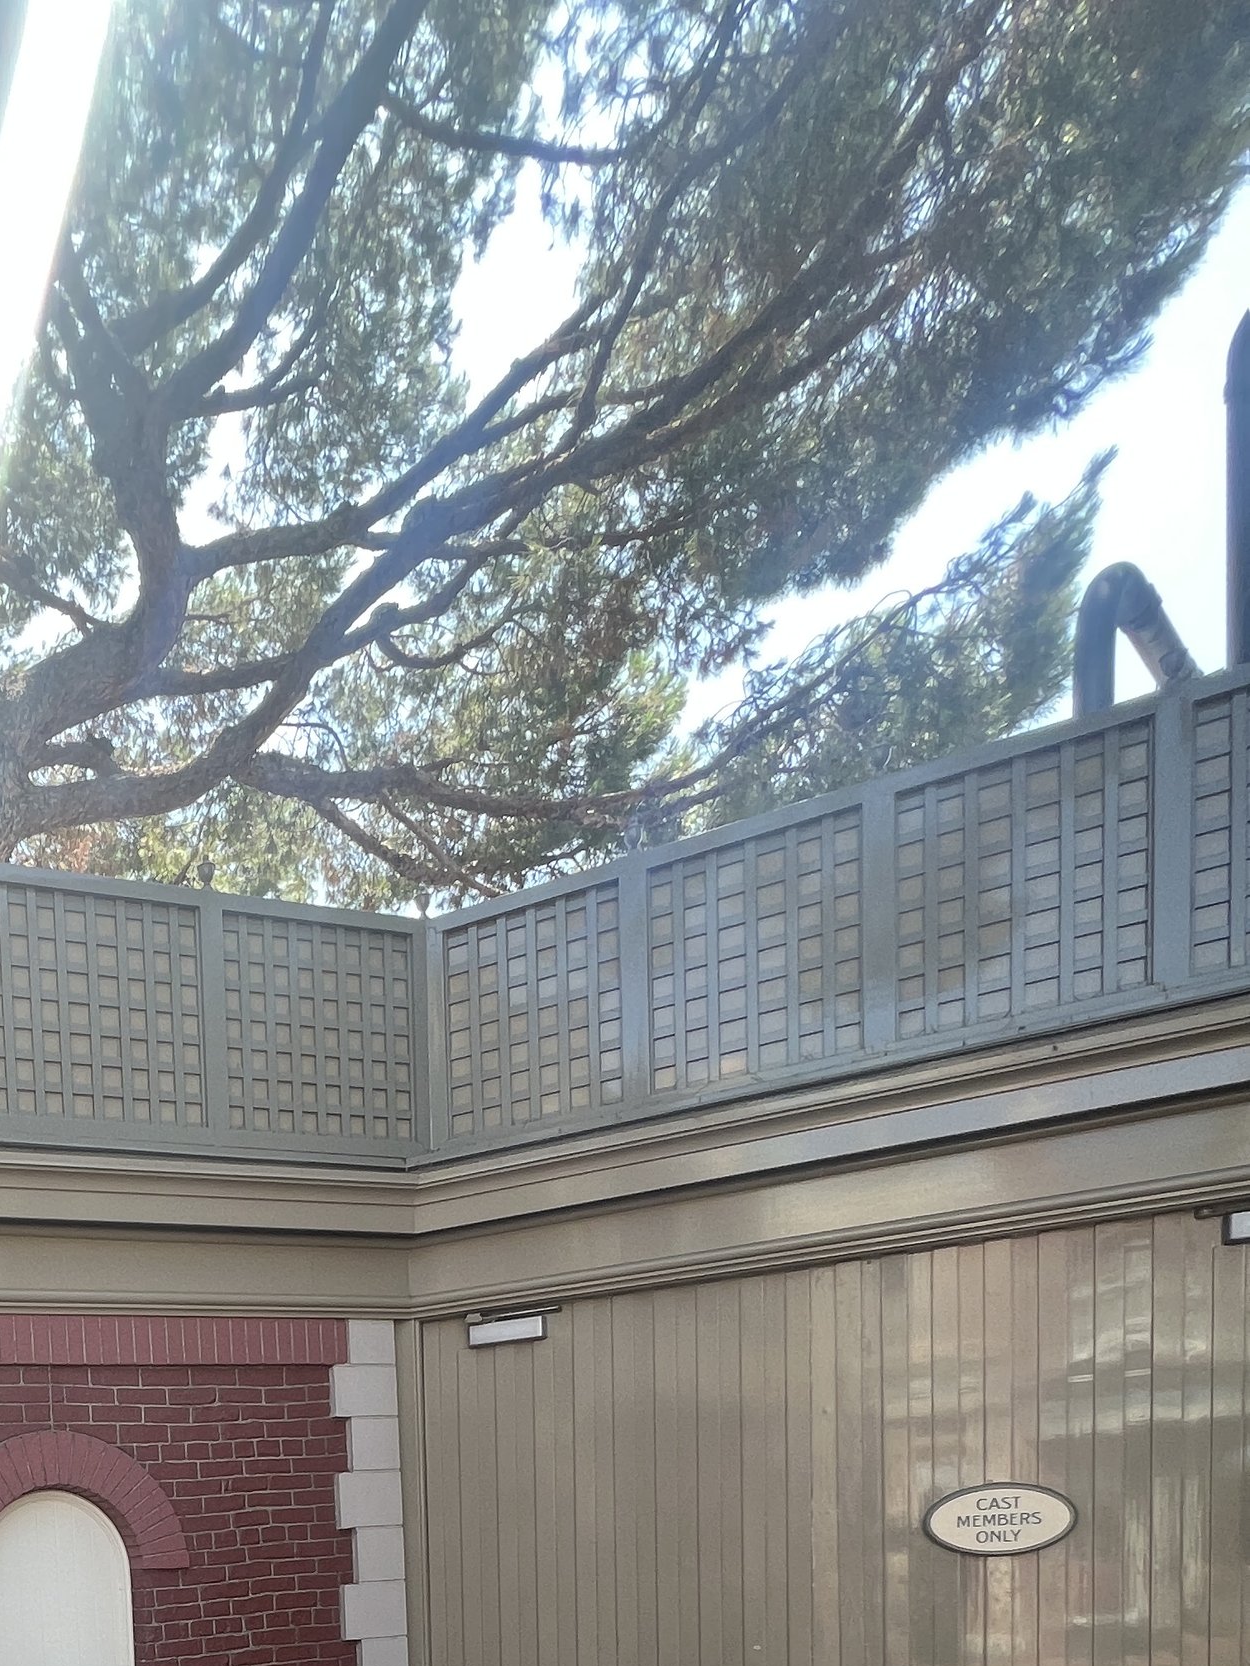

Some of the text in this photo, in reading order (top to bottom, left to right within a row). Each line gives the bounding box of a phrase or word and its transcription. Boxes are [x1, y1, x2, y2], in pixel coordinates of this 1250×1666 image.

[976, 1496, 1021, 1511] CAST
[956, 1512, 1042, 1528] MEMBERS
[975, 1529, 1021, 1544] ONLY
